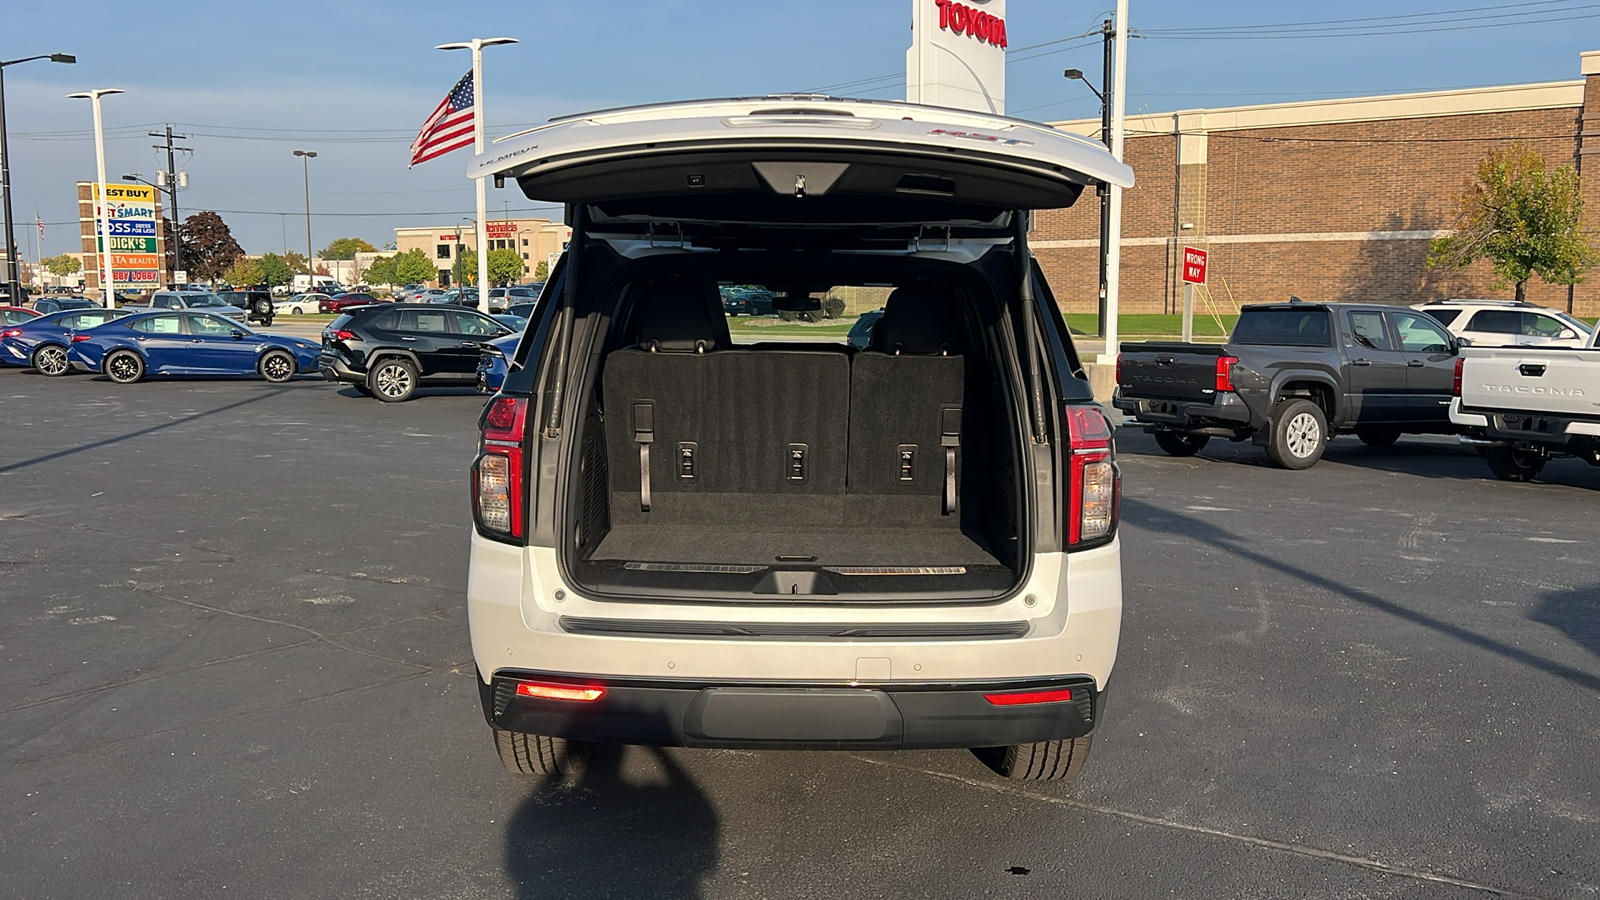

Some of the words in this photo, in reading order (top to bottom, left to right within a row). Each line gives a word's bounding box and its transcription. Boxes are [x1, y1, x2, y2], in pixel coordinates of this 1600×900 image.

[935, 0, 1007, 50] TOYOTA
[479, 159, 495, 168] LE
[497, 144, 539, 161] MIEUX
[98, 188, 125, 197] EST
[97, 206, 153, 217] TSMART
[110, 237, 146, 249] DICK'S
[129, 257, 156, 265] BEAUTY
[1186, 252, 1205, 266] WRONG
[131, 271, 158, 281] LOBBY
[1188, 266, 1201, 279] WAY
[1133, 374, 1198, 384] TACOMA
[1482, 384, 1585, 397] TACOMA
